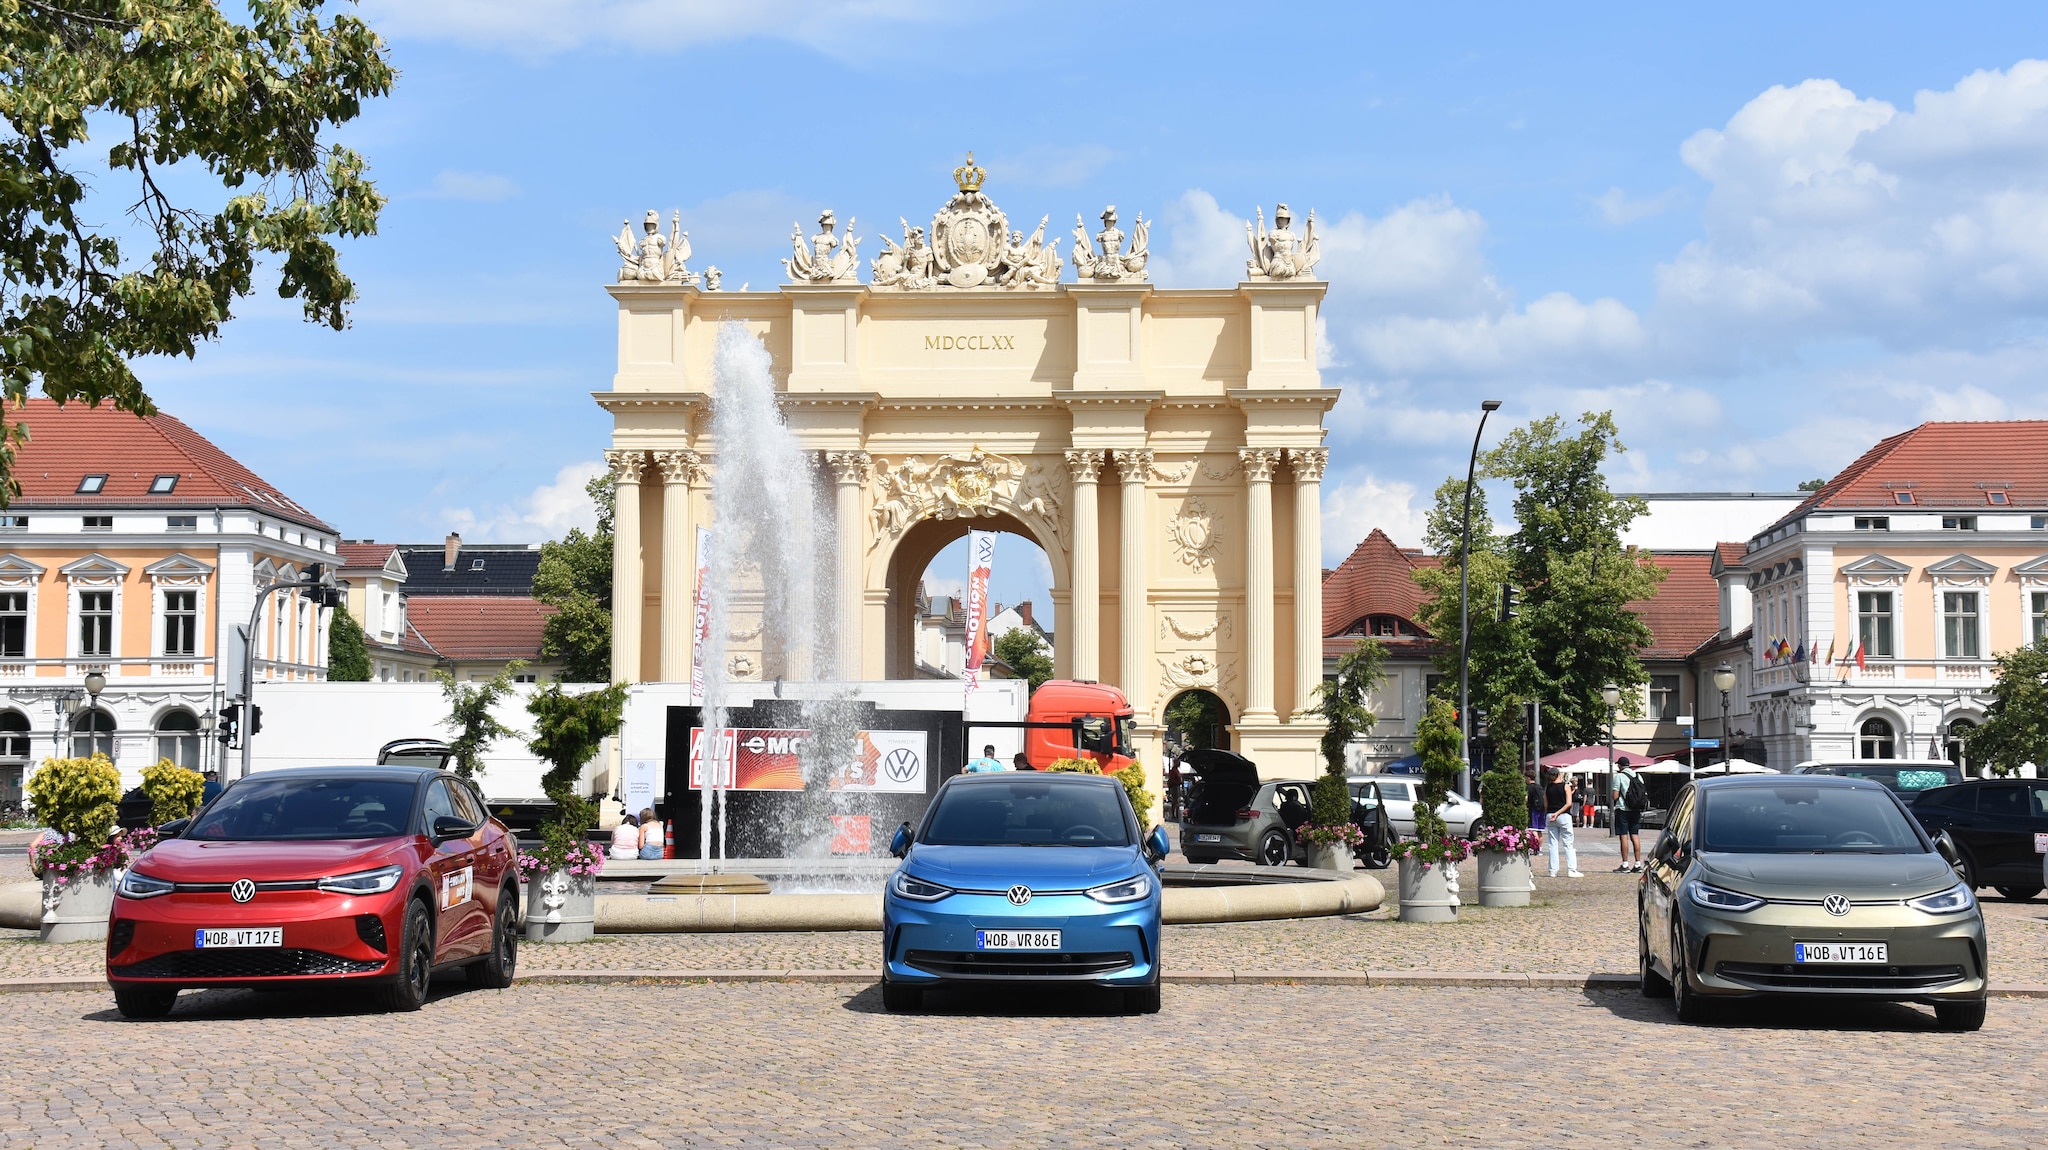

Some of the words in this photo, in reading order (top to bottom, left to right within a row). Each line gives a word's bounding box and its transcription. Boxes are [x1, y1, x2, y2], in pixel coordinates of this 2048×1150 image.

[924, 335, 1015, 350] MDCCLXX
[1373, 744, 1393, 752] KPM
[205, 932, 228, 945] WOB
[985, 933, 1008, 947] WOB
[1804, 946, 1830, 960] WOB
